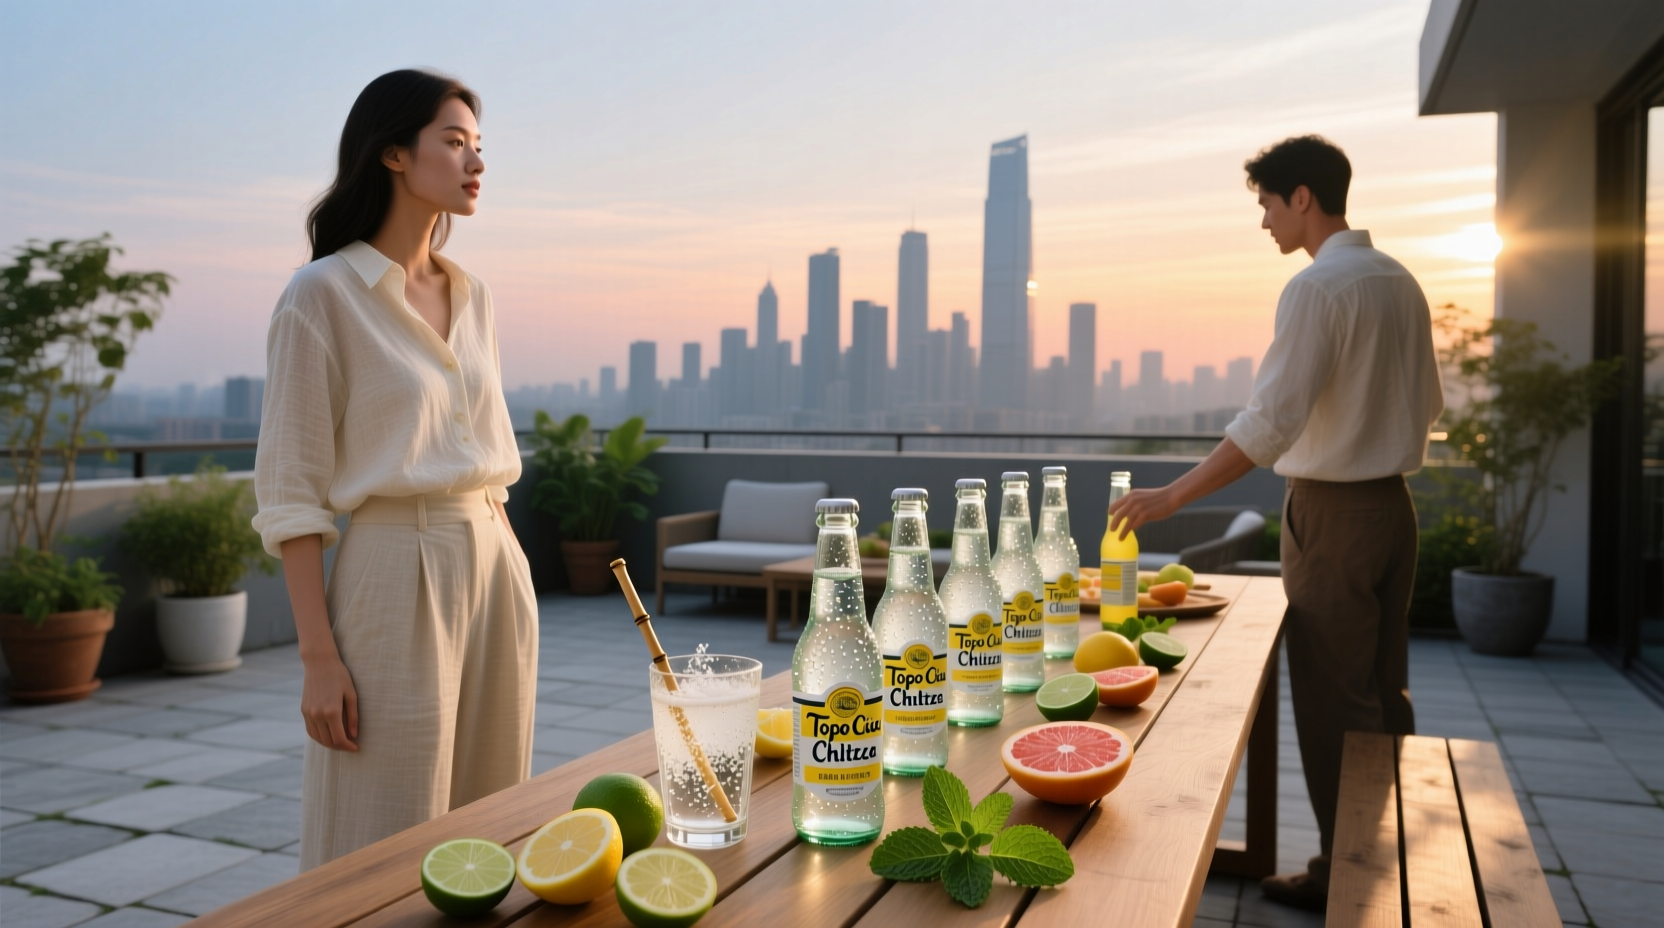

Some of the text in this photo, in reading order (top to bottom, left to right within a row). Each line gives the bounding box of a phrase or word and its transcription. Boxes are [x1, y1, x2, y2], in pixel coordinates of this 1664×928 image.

[955, 633, 984, 650] Topo
[885, 665, 923, 690] Topo
[806, 712, 850, 742] Topo
